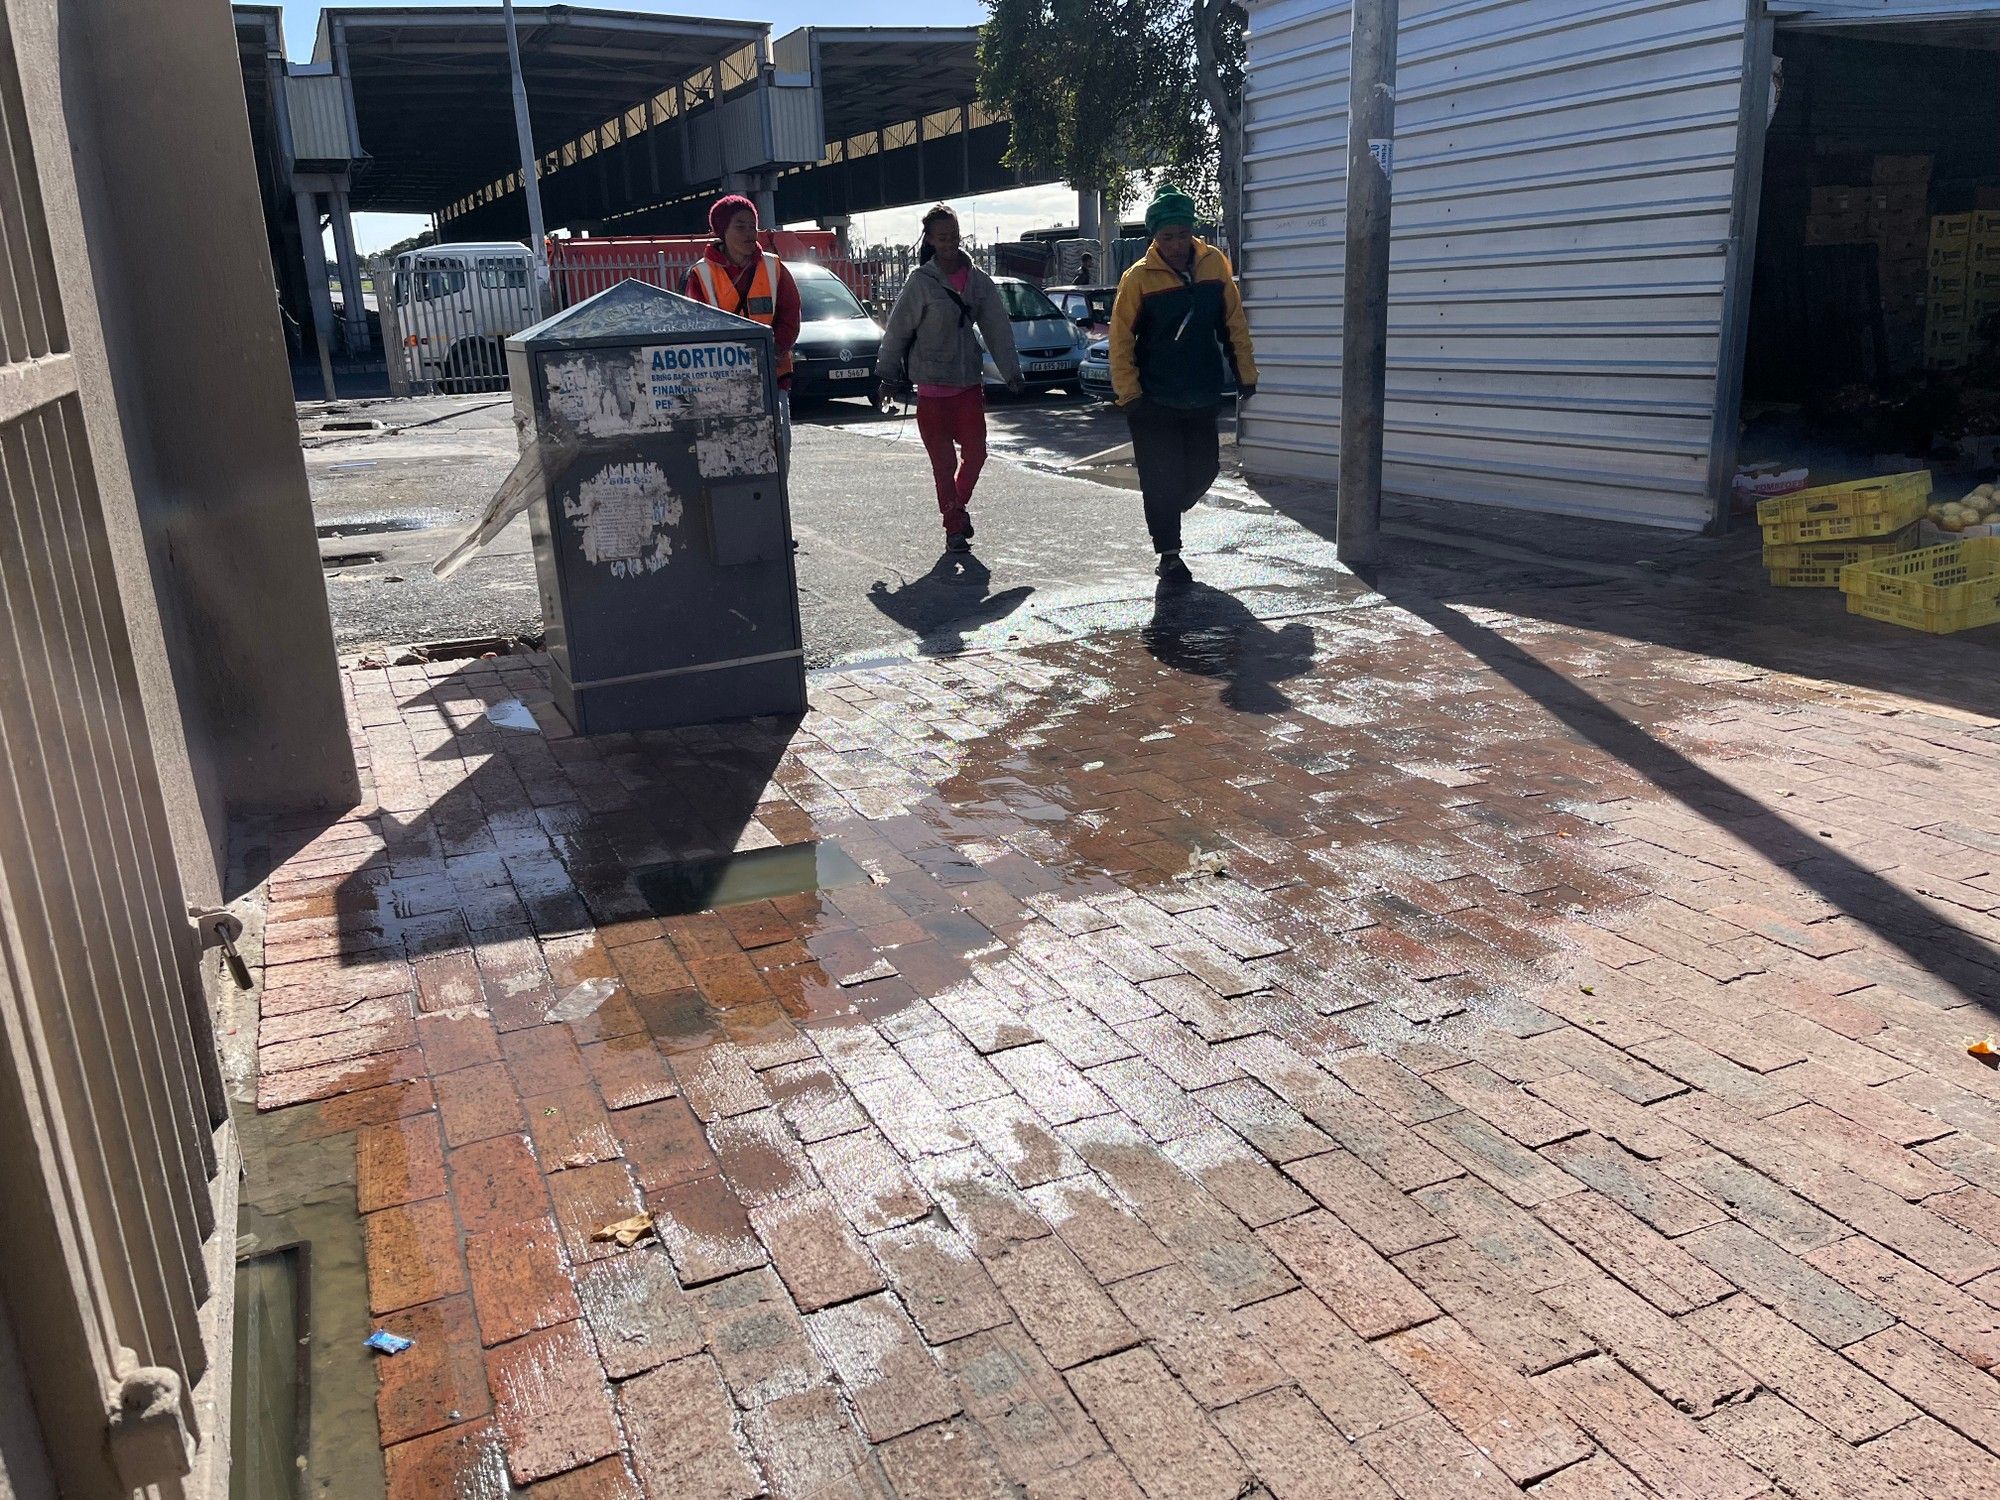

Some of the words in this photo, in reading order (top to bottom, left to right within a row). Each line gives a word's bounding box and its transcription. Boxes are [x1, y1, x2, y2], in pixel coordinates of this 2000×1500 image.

[651, 346, 752, 371] ABORTION
[651, 372, 672, 381] BRING
[673, 371, 691, 380] BACK
[692, 371, 708, 380] LOST
[709, 370, 730, 379] LOVER
